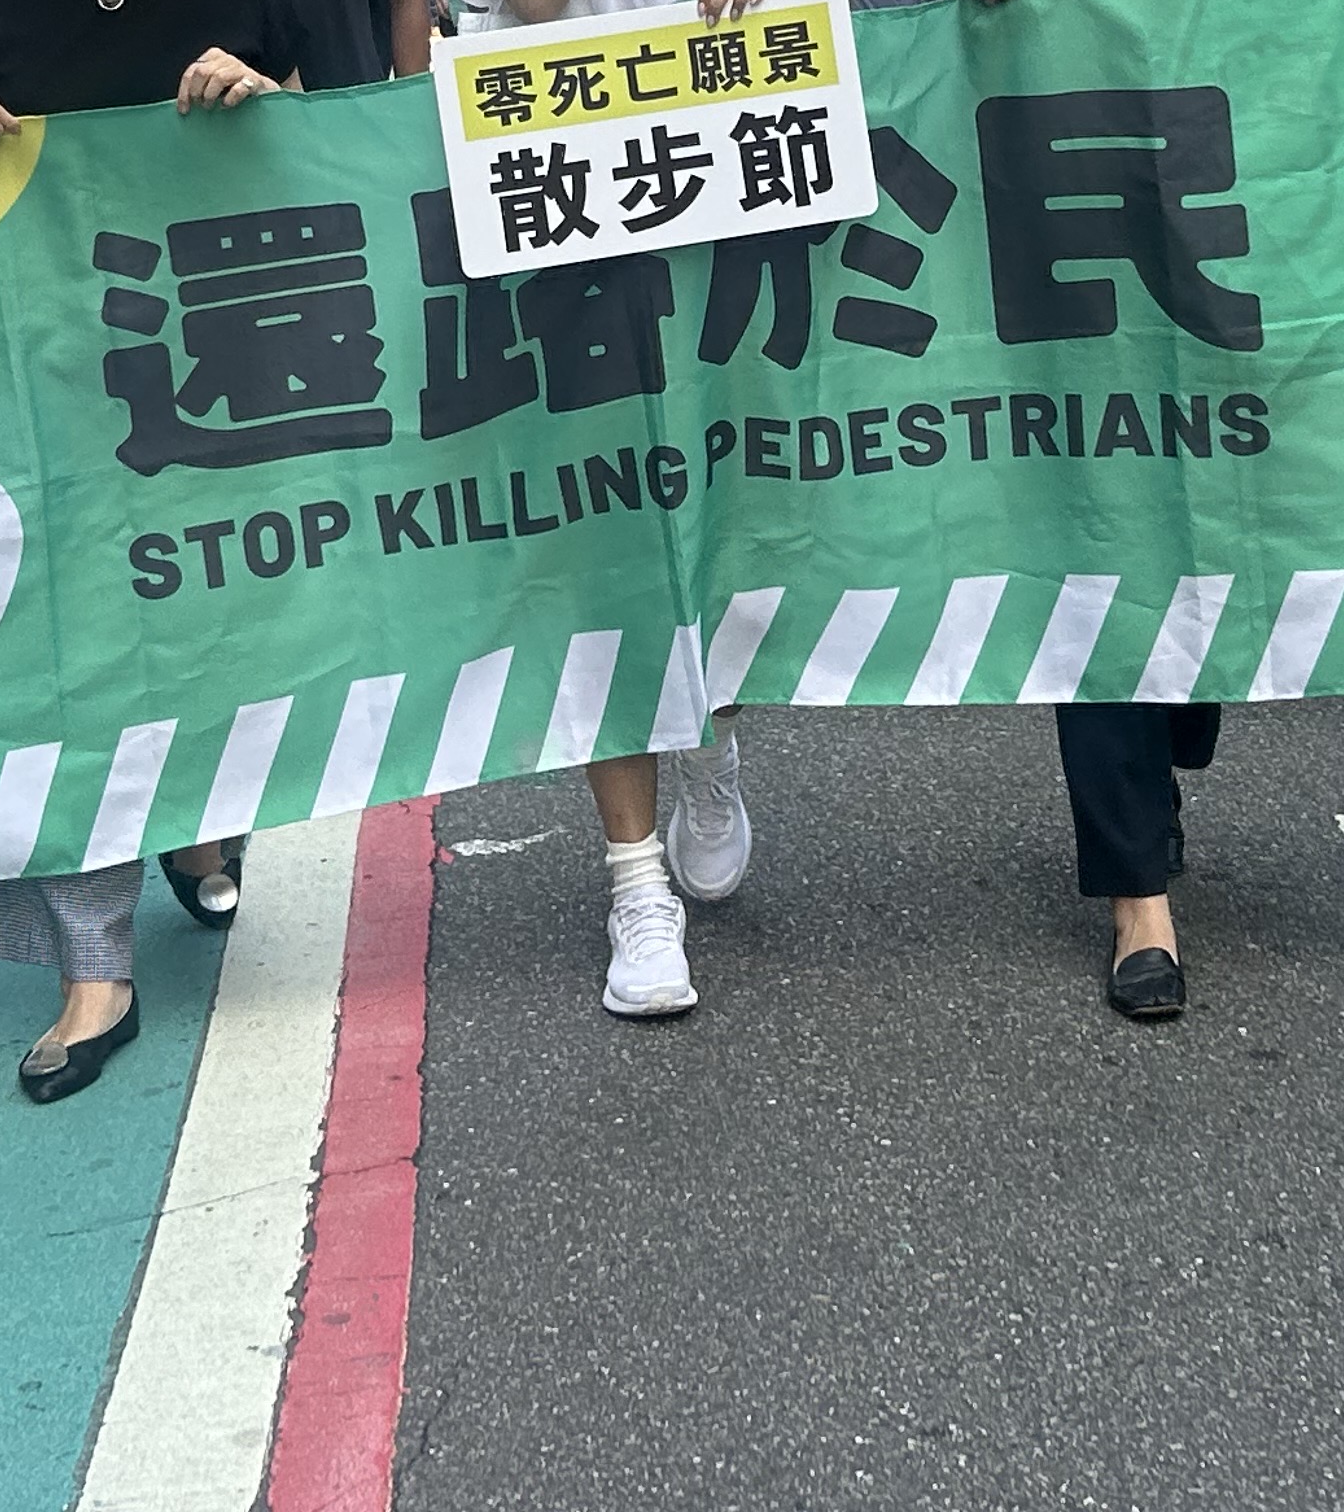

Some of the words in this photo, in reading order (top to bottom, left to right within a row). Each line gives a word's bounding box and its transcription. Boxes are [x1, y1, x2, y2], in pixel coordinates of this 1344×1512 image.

[474, 20, 820, 128] 零死亡願景
[488, 104, 836, 254] 散步節
[93, 86, 1266, 478] 還路於民
[128, 497, 354, 601] STOP
[377, 441, 690, 556] KILLING
[704, 389, 1273, 490] PEDESTRIANS
